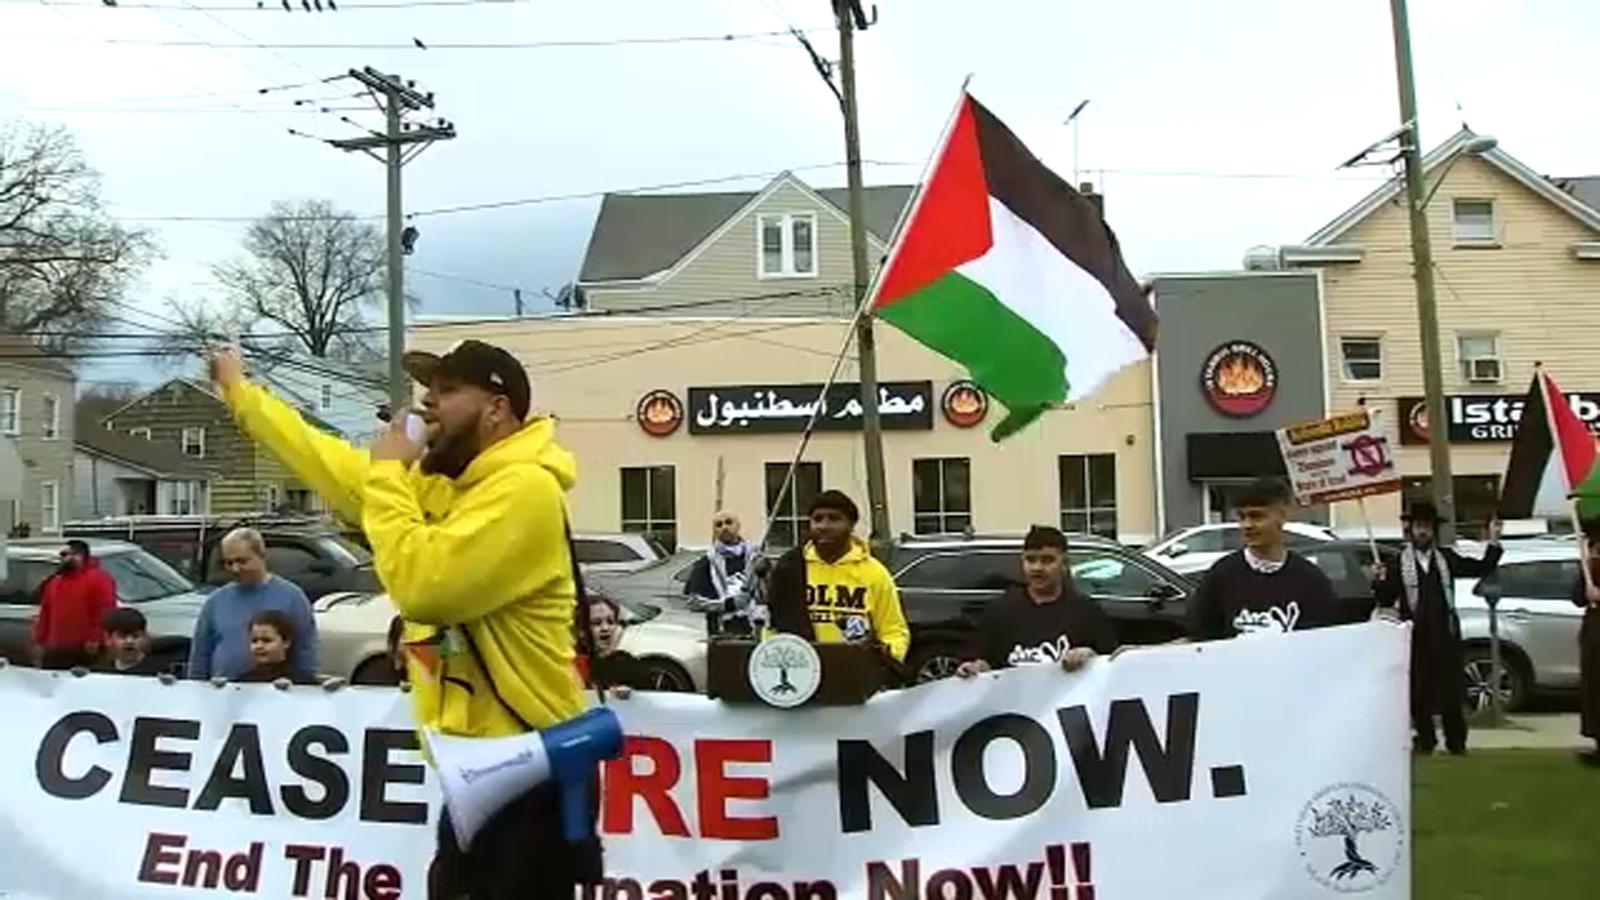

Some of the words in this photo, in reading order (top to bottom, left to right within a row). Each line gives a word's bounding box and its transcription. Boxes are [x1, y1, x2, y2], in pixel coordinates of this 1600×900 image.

[833, 387, 924, 418] مطم
[35, 711, 428, 825] CEASE
[599, 733, 779, 841] RE
[837, 692, 1247, 834] NOW.
[137, 832, 264, 893] End
[285, 844, 401, 900] The
[866, 842, 1095, 900] Now!!
